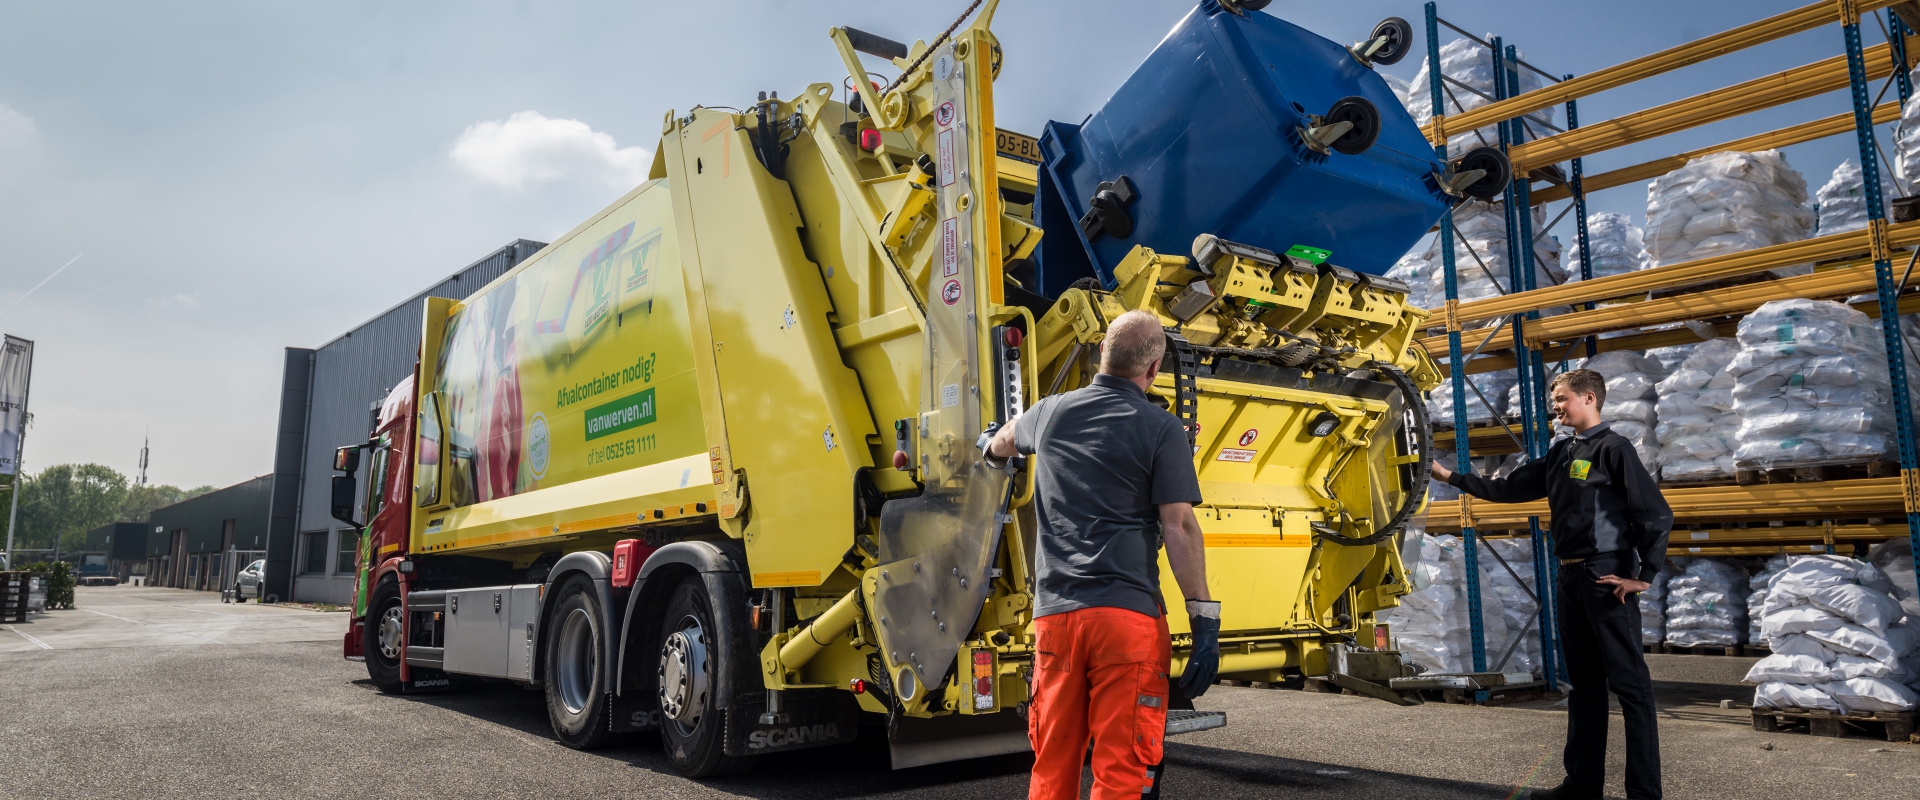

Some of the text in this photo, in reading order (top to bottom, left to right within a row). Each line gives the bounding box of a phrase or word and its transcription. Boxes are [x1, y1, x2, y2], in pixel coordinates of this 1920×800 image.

[997, 134, 1041, 159] 05-BL
[556, 352, 656, 409] Afvalcontainer nodig?
[588, 395, 652, 434] vanwerven.nl
[588, 433, 656, 466] of bel 0525 63 1111
[414, 679, 449, 687] SCANIA
[749, 722, 840, 749] SCANIA
